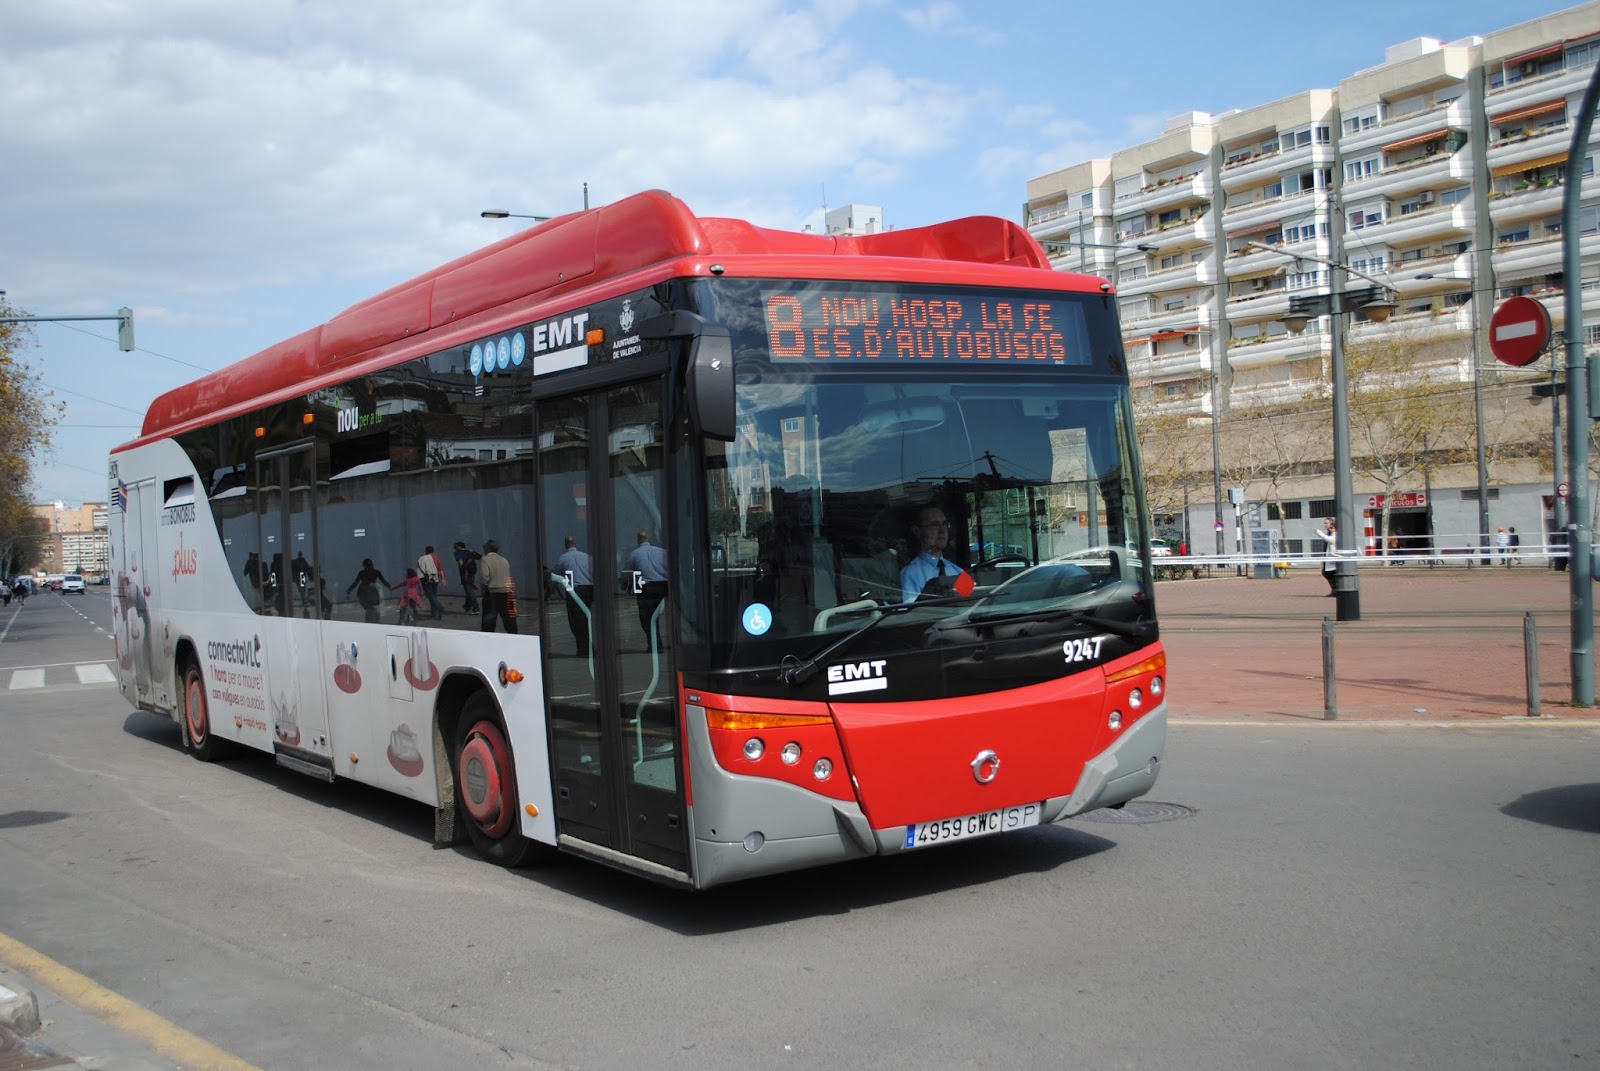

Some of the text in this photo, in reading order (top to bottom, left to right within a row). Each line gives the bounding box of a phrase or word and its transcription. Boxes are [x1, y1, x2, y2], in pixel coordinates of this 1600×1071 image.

[766, 295, 806, 357] 8
[821, 297, 1054, 331] NOU HOSP. LA FE
[533, 312, 589, 353] EMT
[612, 350, 620, 360] DE
[337, 406, 382, 433] nou per a tu
[172, 530, 198, 585] plus
[208, 634, 261, 668] connectaVLC
[1062, 636, 1104, 663] 9247
[214, 664, 227, 684] hora
[228, 672, 237, 688] per
[827, 660, 887, 682] EMT
[918, 818, 962, 843] 4959
[967, 811, 998, 834] GWC
